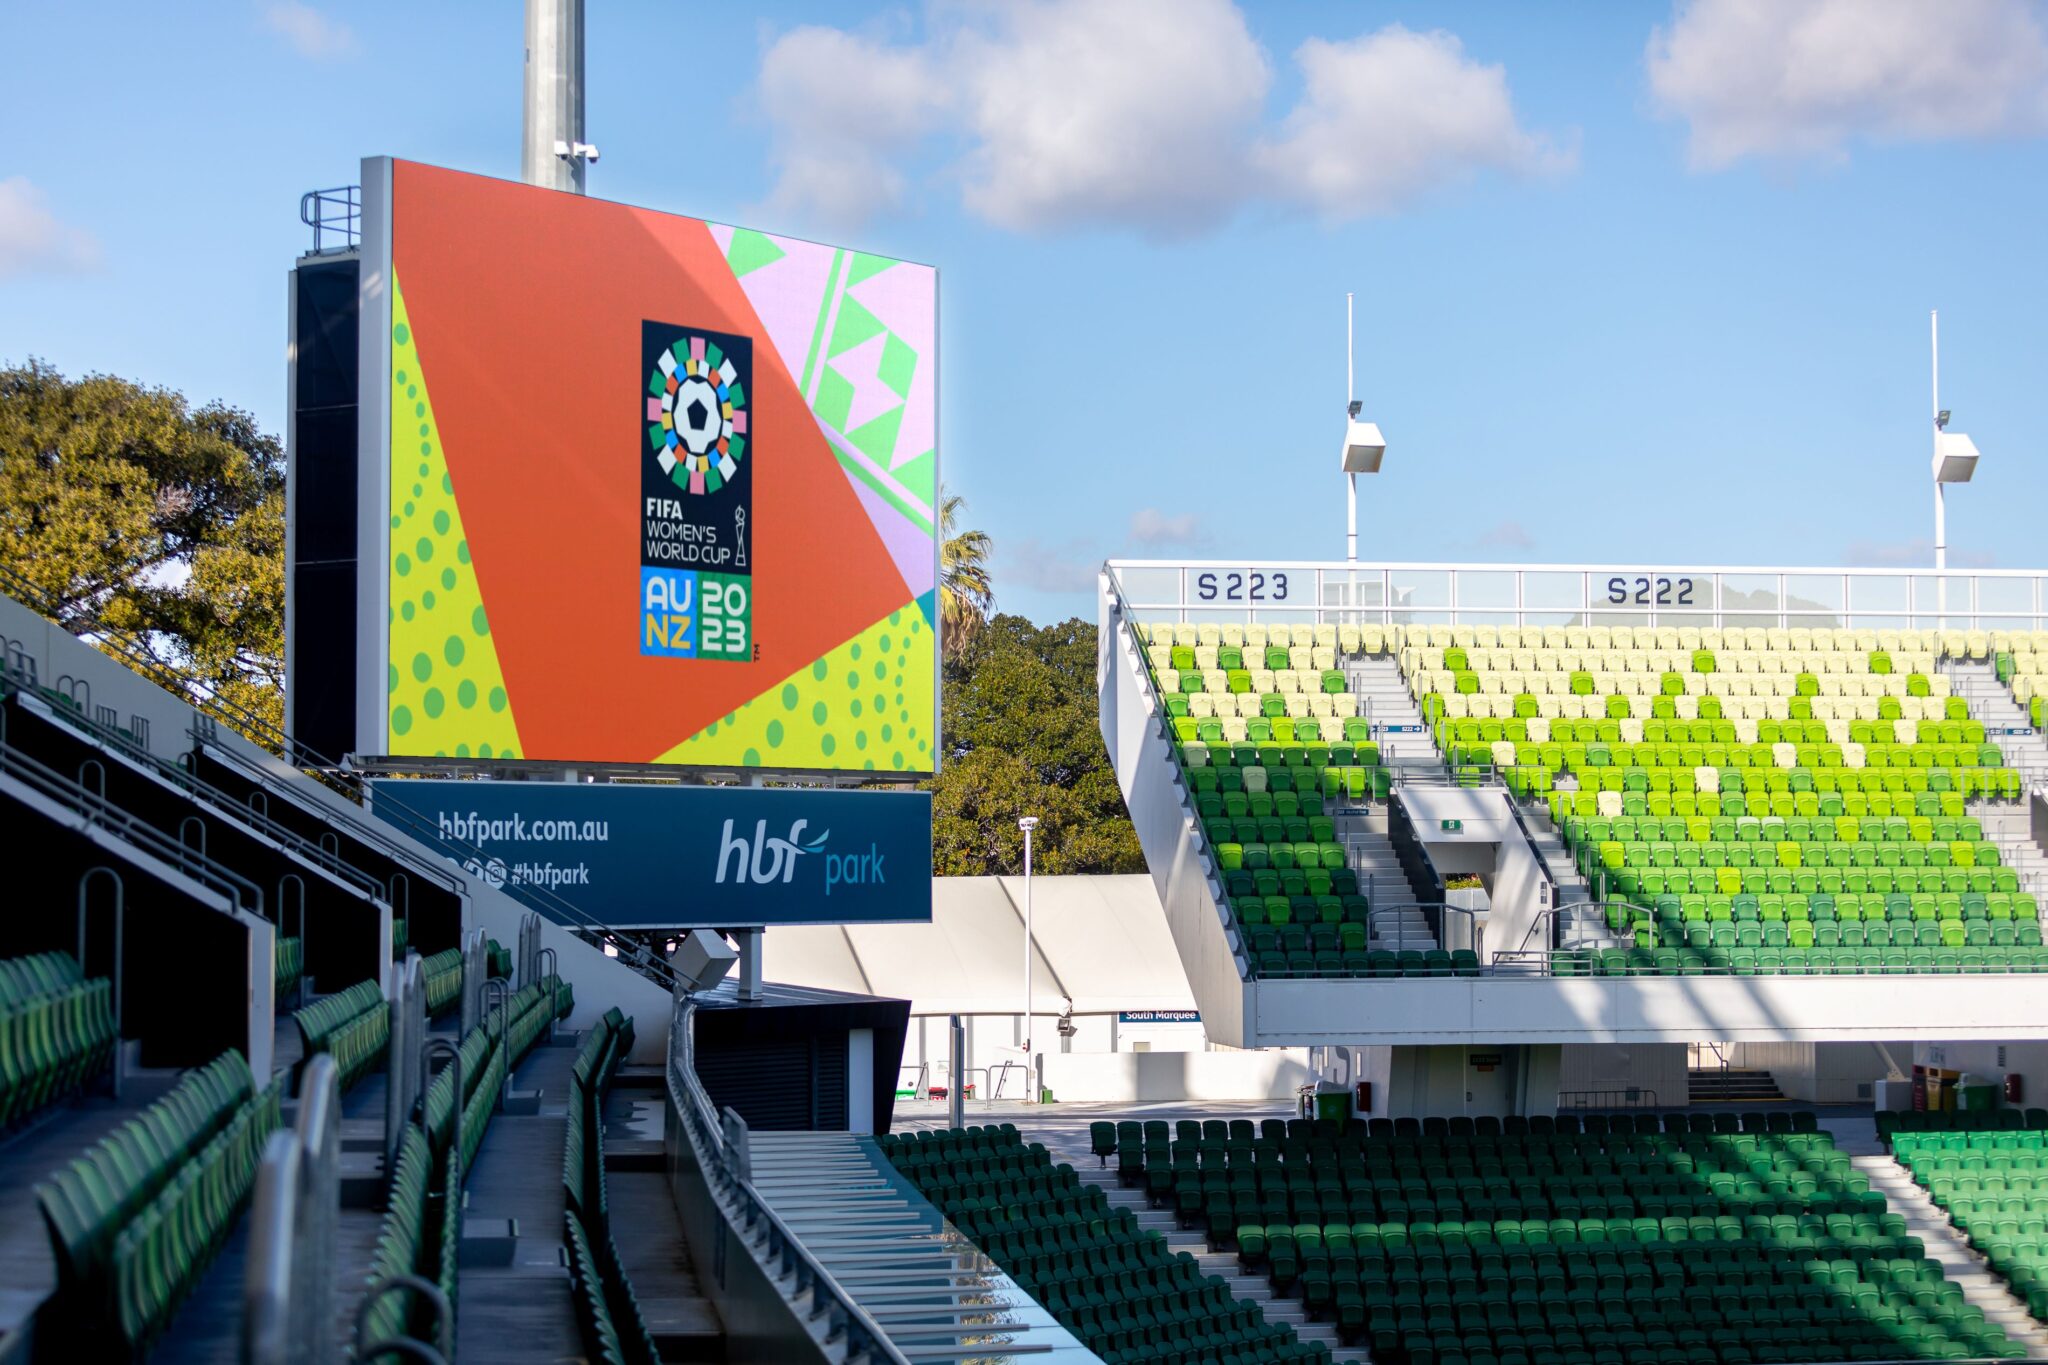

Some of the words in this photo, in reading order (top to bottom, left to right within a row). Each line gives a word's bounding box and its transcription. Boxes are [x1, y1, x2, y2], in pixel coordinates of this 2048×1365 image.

[646, 497, 683, 520] FIFA
[646, 520, 717, 544] WOMEN'S
[646, 540, 699, 562] WORLD
[701, 546, 731, 565] CUP
[646, 576, 692, 612] AU
[702, 580, 747, 617] 20
[1198, 573, 1288, 600] S223
[1608, 577, 1693, 604] S222
[646, 612, 691, 650] NZ
[702, 616, 746, 653] 23
[439, 811, 608, 848] hbfpark.com.au
[715, 818, 808, 884] hbf
[825, 842, 885, 896] park
[511, 862, 589, 890] #hbfpark
[1126, 1011, 1153, 1020] South
[1155, 1011, 1196, 1021] Marquee
